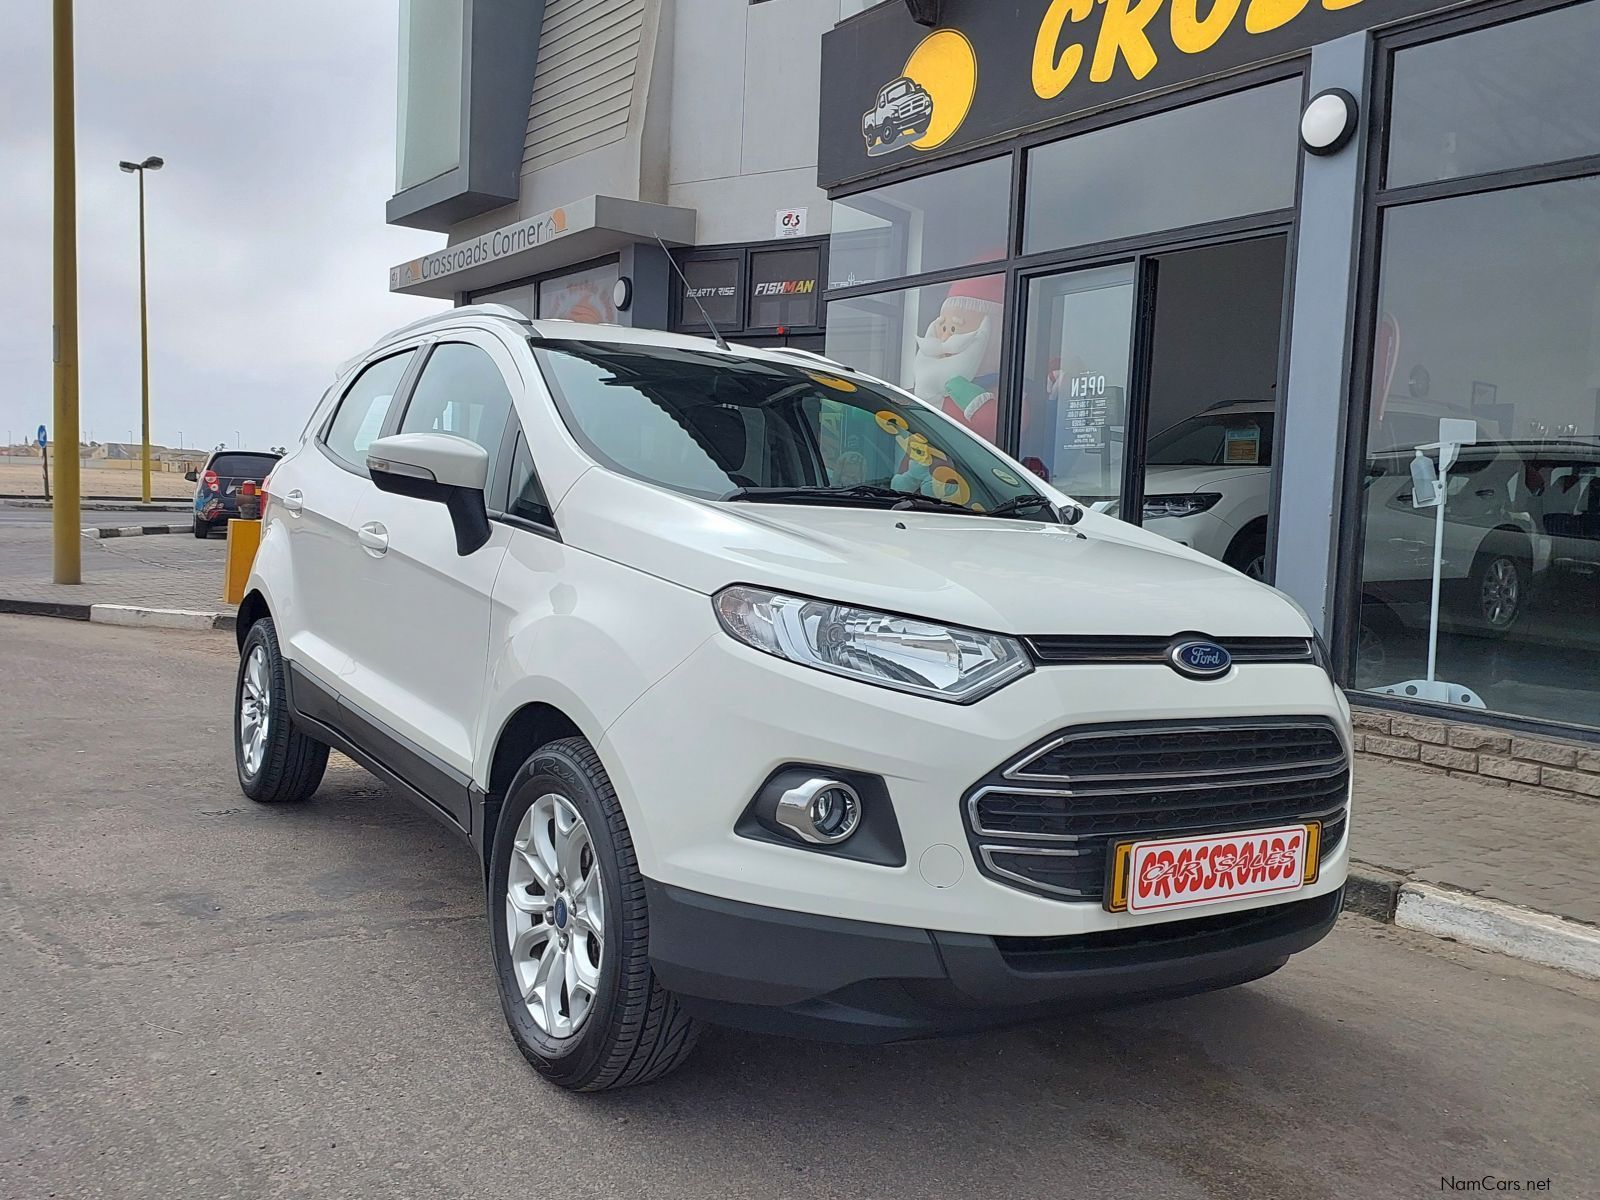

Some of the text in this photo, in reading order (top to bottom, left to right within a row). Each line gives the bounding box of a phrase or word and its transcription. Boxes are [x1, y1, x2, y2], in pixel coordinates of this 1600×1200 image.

[421, 220, 544, 280] Crossroads Corner
[686, 286, 736, 298] HEARTY RISE
[754, 279, 815, 297] FISHMAN
[1190, 647, 1221, 665] Ford
[1138, 836, 1300, 898] CROSSROADS
[1142, 849, 1297, 882] CAR SALES
